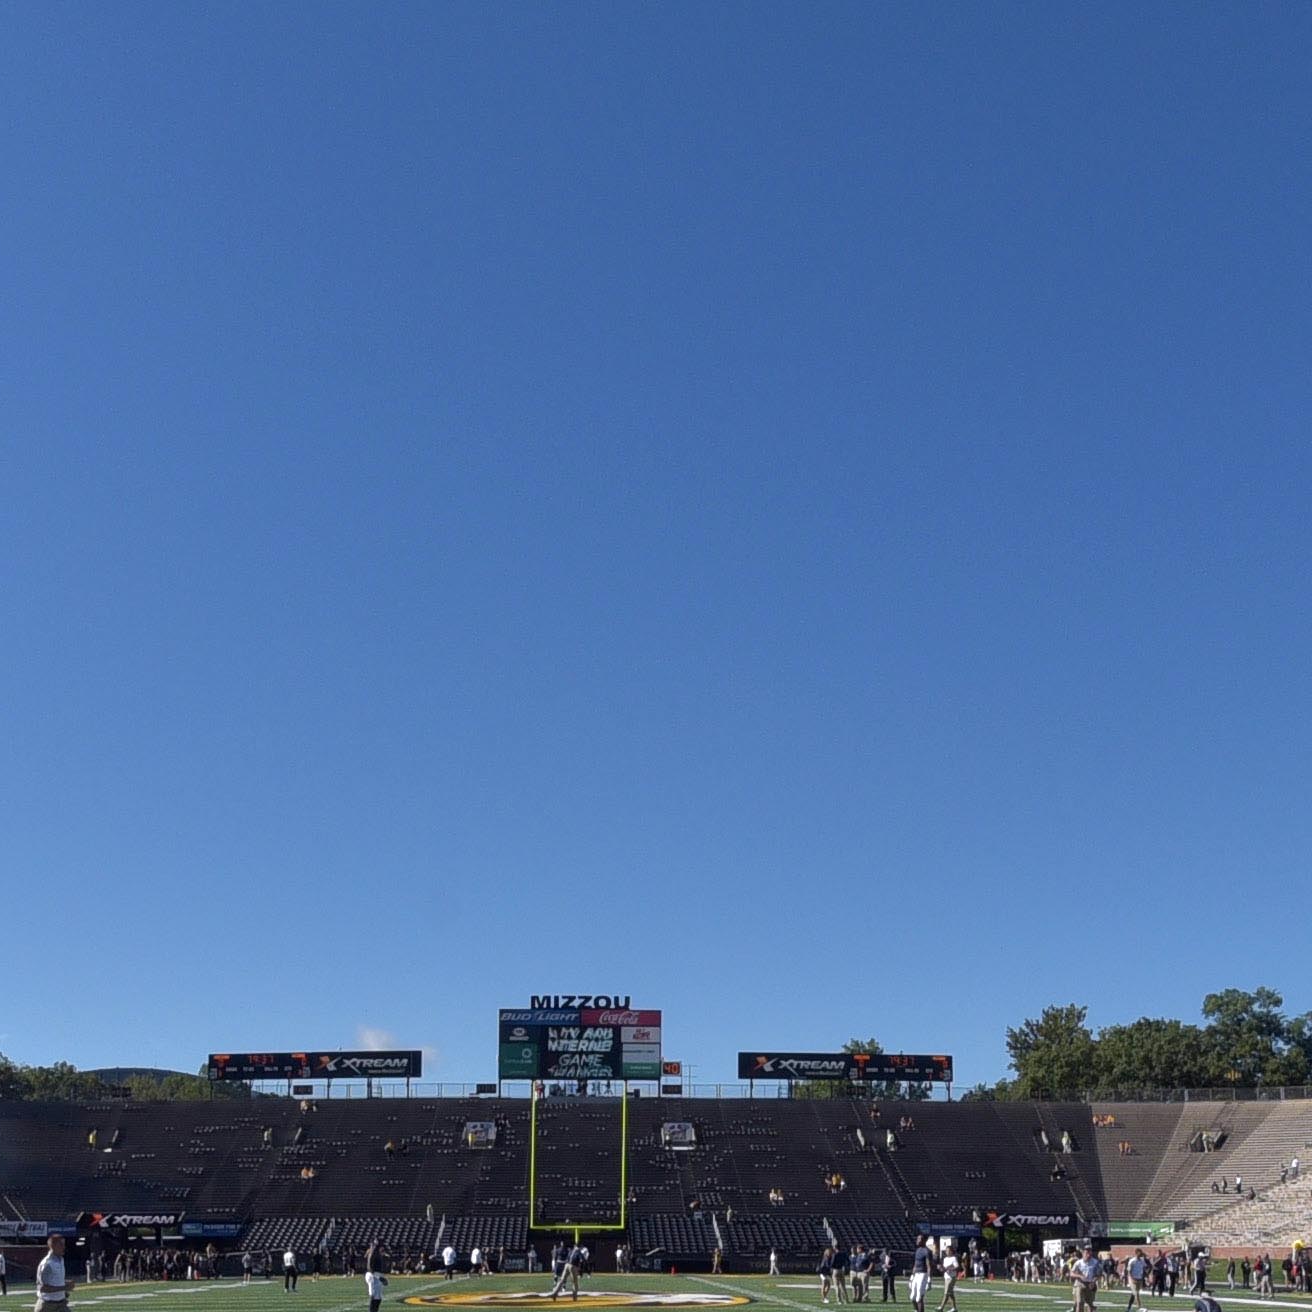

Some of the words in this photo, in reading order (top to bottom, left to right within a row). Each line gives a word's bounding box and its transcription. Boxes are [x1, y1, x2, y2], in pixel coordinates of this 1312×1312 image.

[530, 995, 631, 1010] MIZZOU
[500, 1012, 532, 1021] BUD
[535, 1011, 579, 1021] LIGHT
[341, 1058, 409, 1074] XTREAM
[663, 1062, 679, 1074] 40
[777, 1059, 846, 1076] XTREAM
[112, 1214, 175, 1226] XTREAM
[1007, 1214, 1070, 1227] XTREAM
